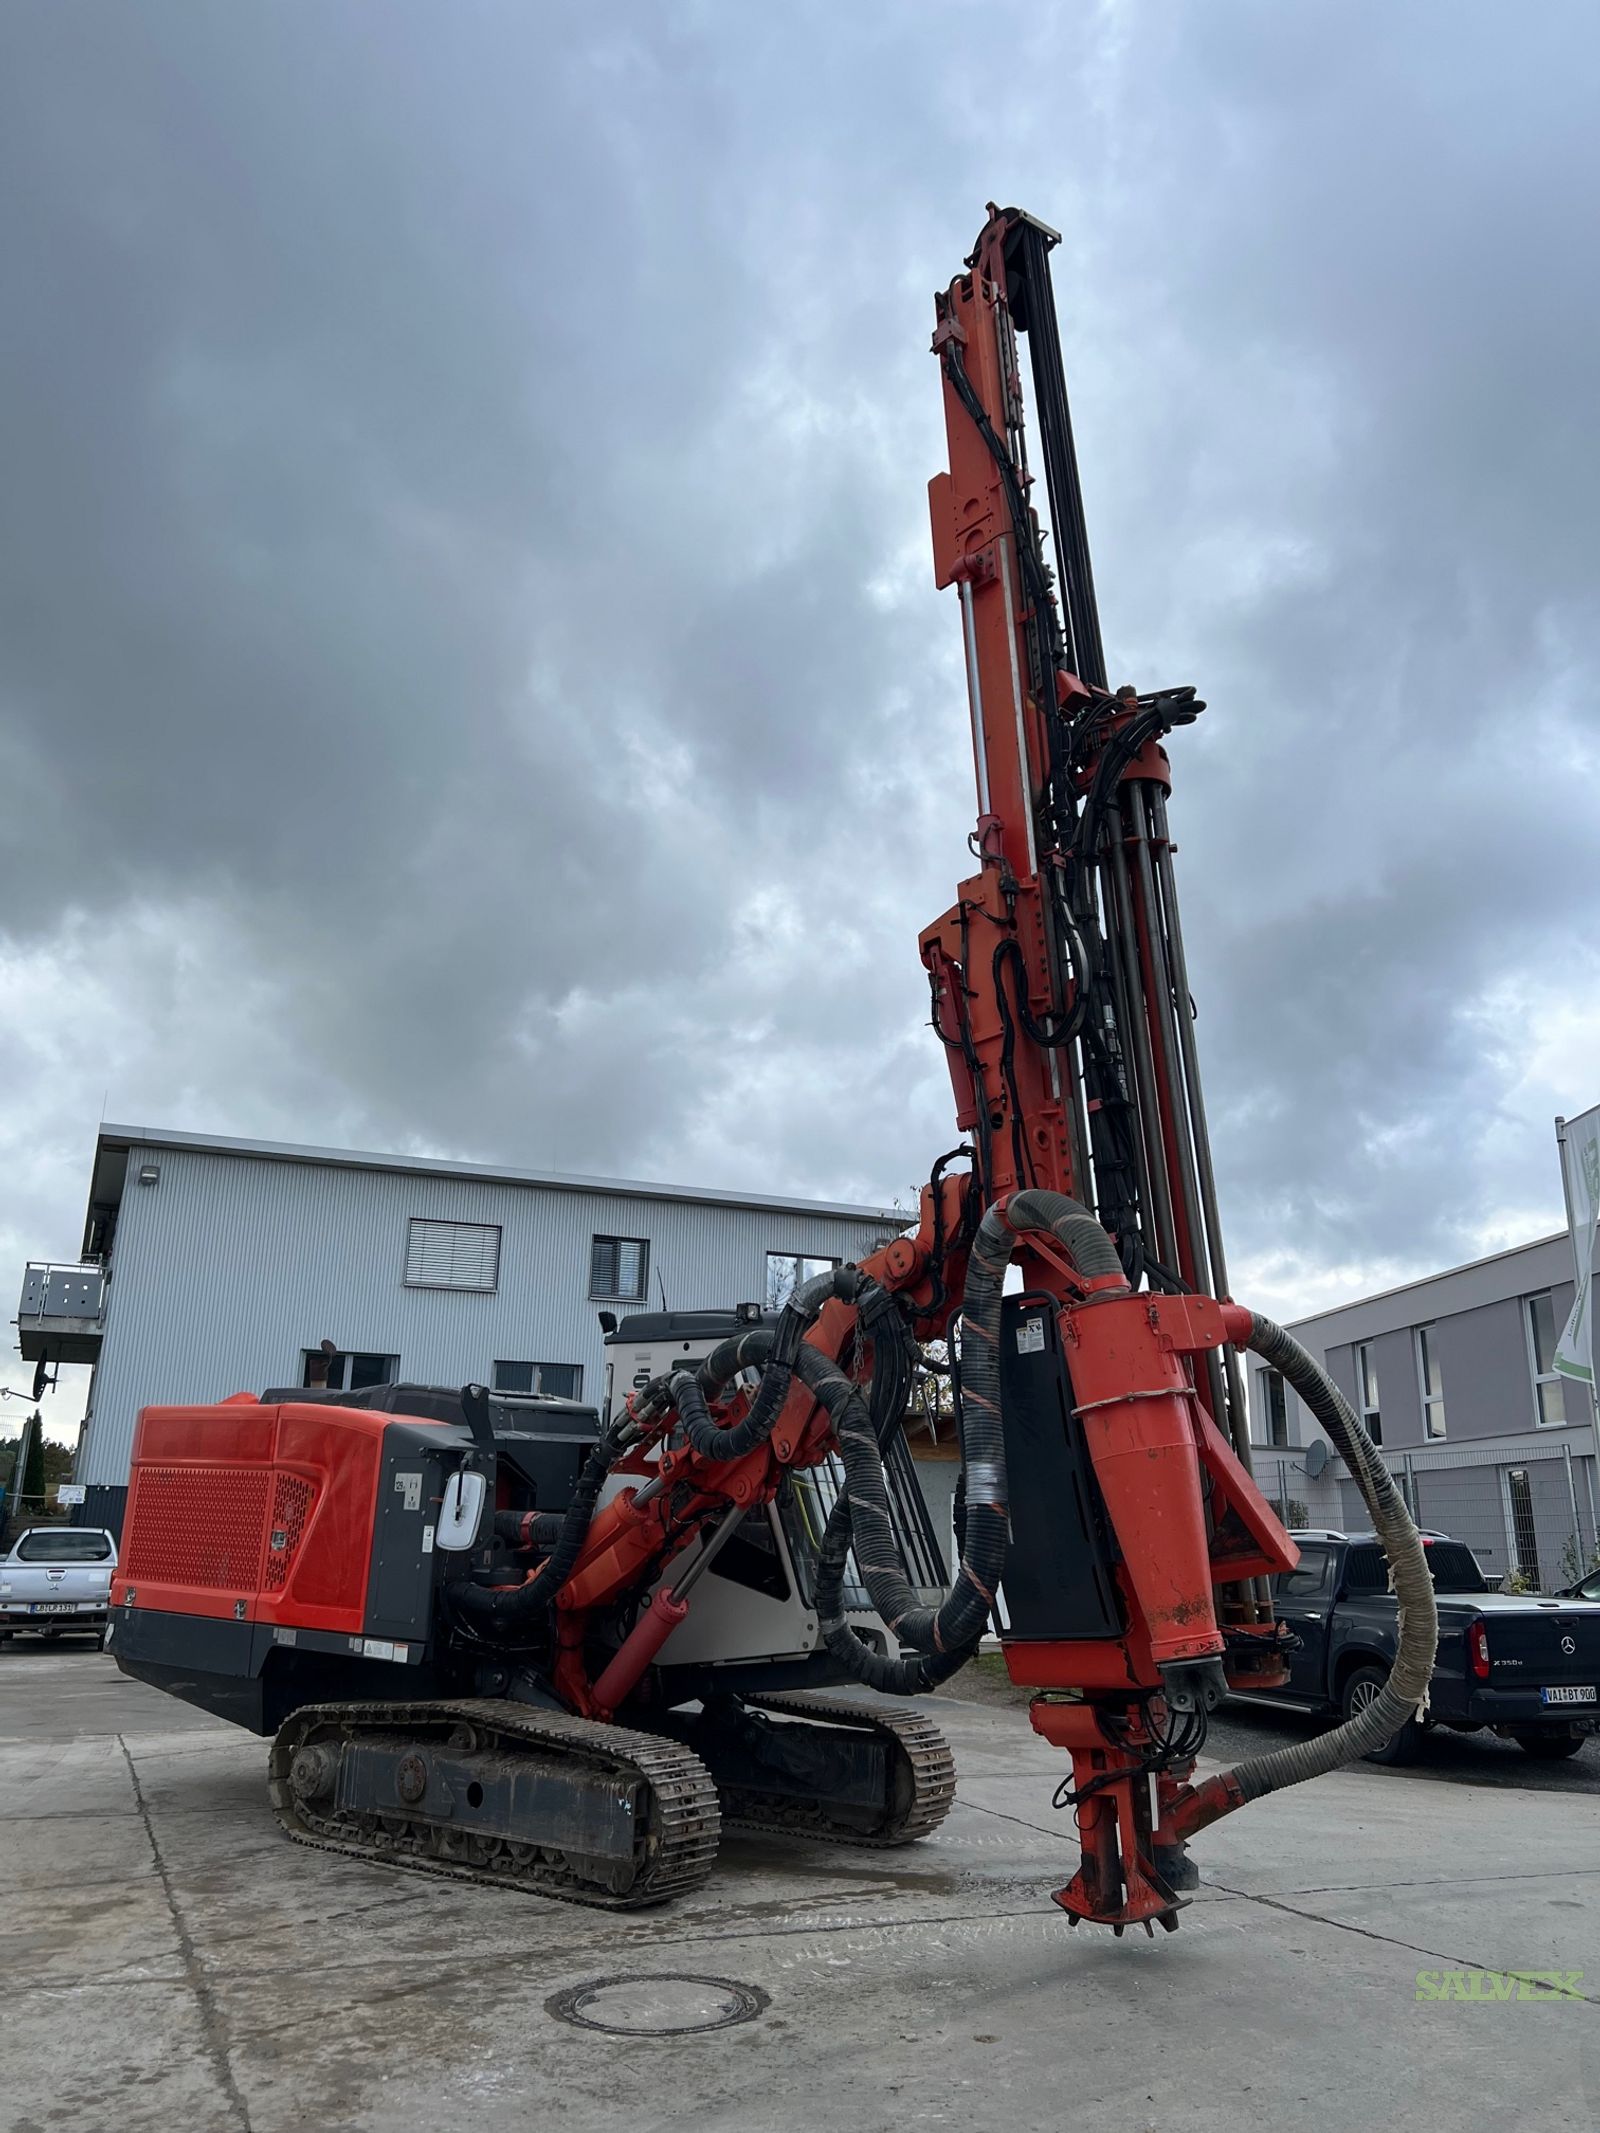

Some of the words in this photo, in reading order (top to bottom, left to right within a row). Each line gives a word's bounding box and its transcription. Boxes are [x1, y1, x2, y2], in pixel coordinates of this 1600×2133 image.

[1547, 1689, 1562, 1701] VAI
[1568, 1688, 1578, 1700] BT
[1580, 1688, 1595, 1700] 900
